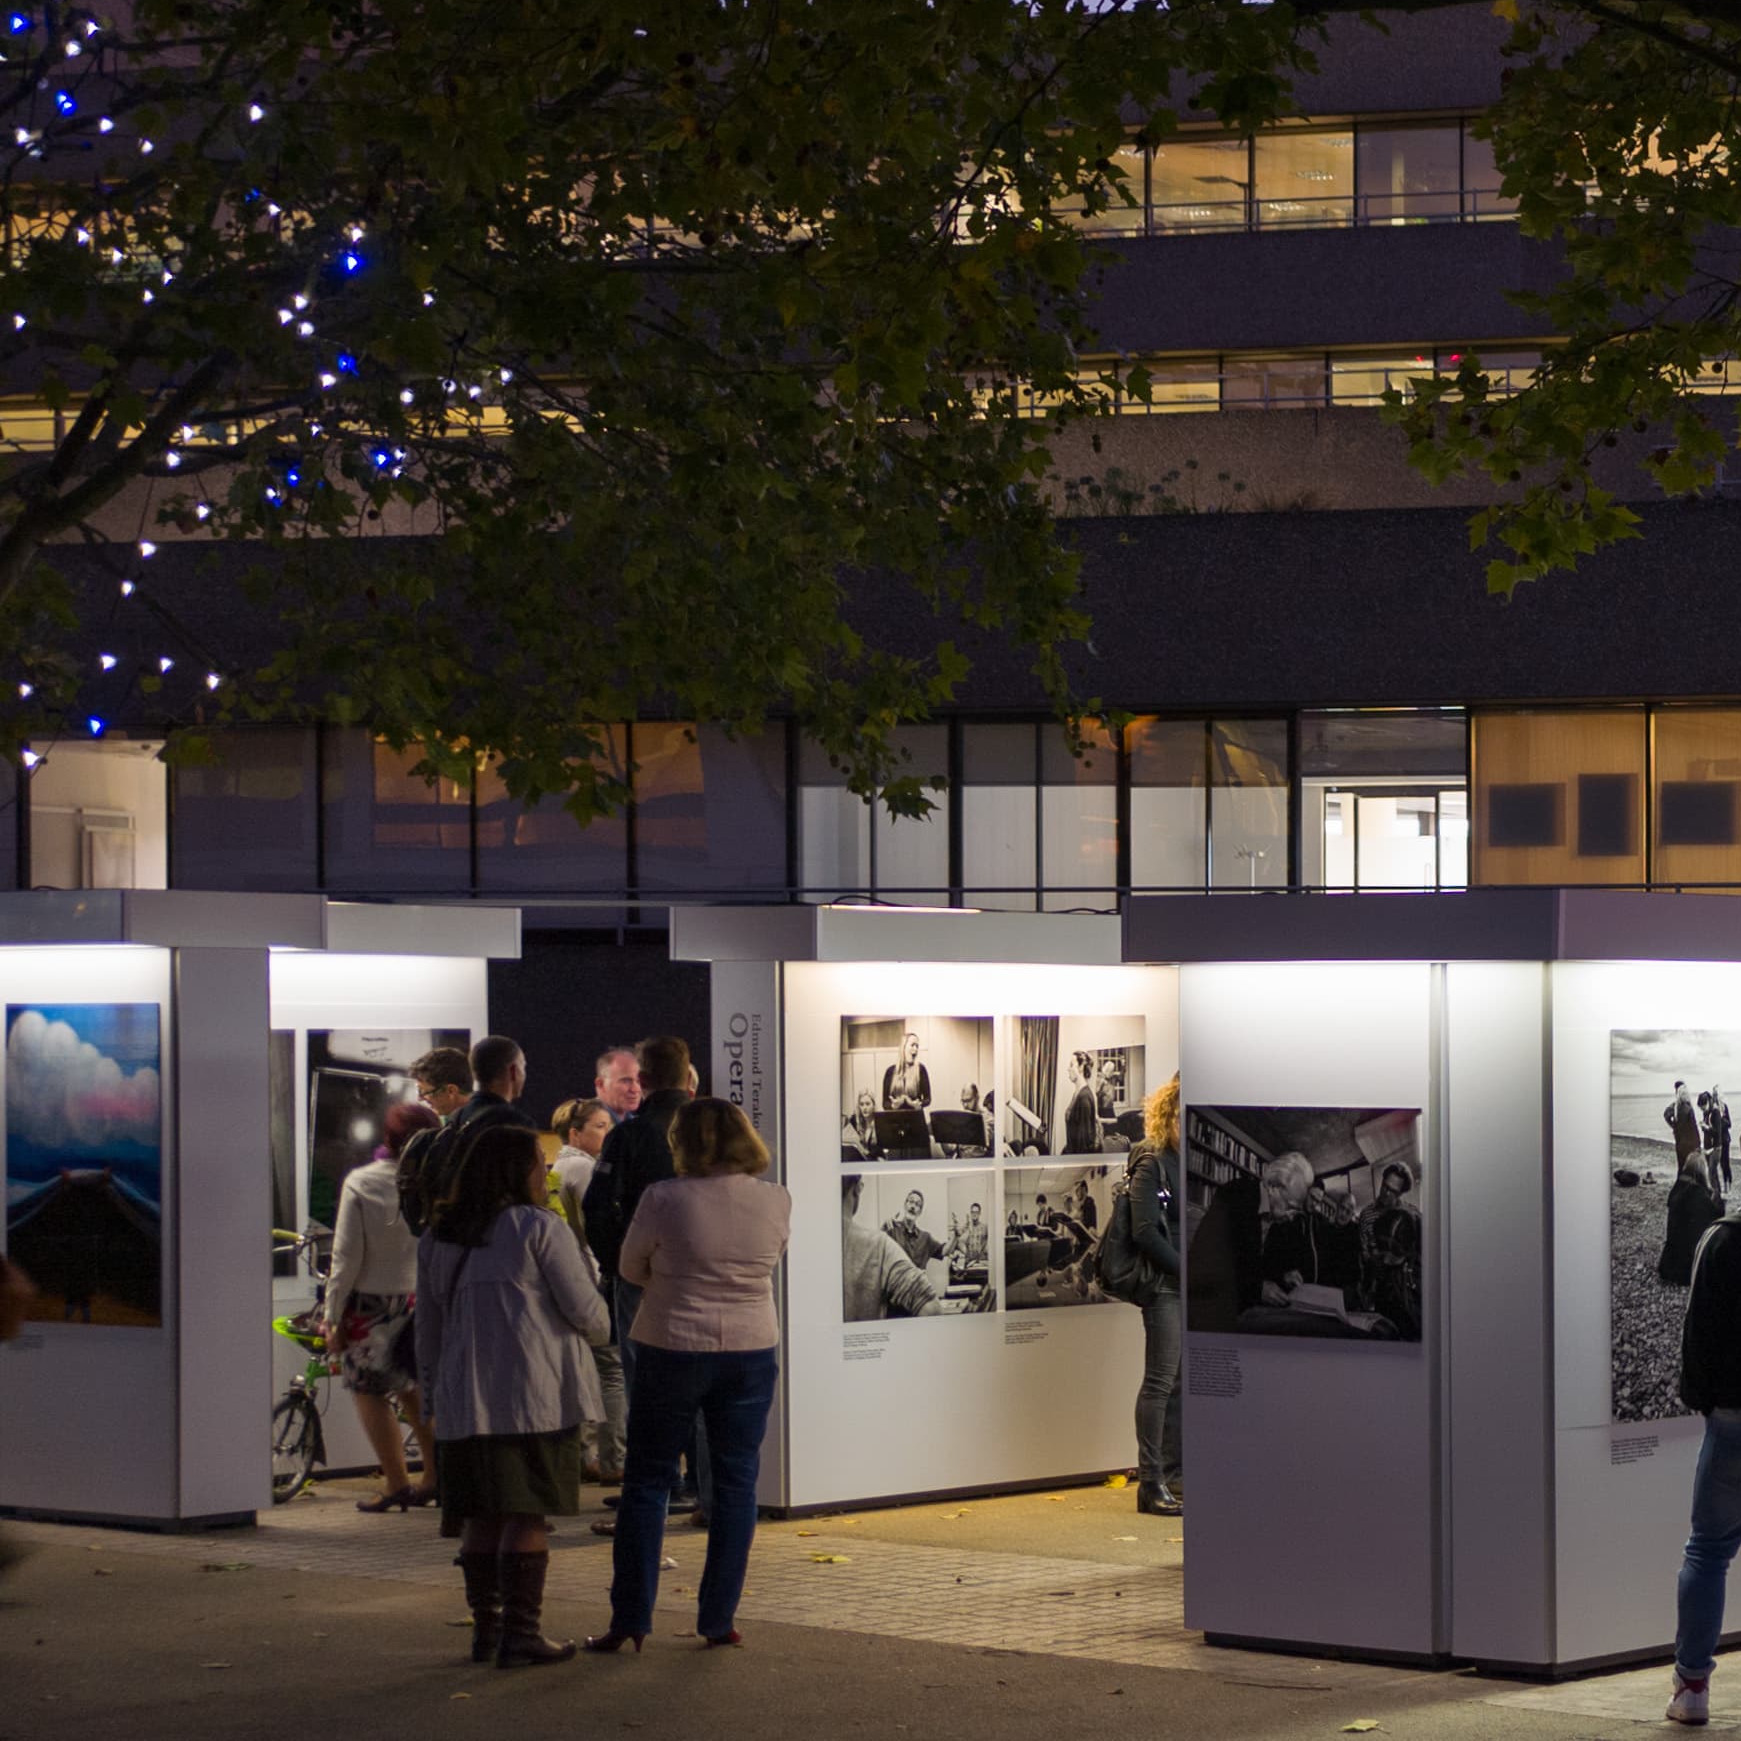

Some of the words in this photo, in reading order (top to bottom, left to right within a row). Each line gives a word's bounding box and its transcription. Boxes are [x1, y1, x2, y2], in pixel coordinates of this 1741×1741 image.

[723, 1012, 749, 1106] Opera
[751, 1014, 762, 1074] Edmond
[751, 1080, 763, 1129] Terako
